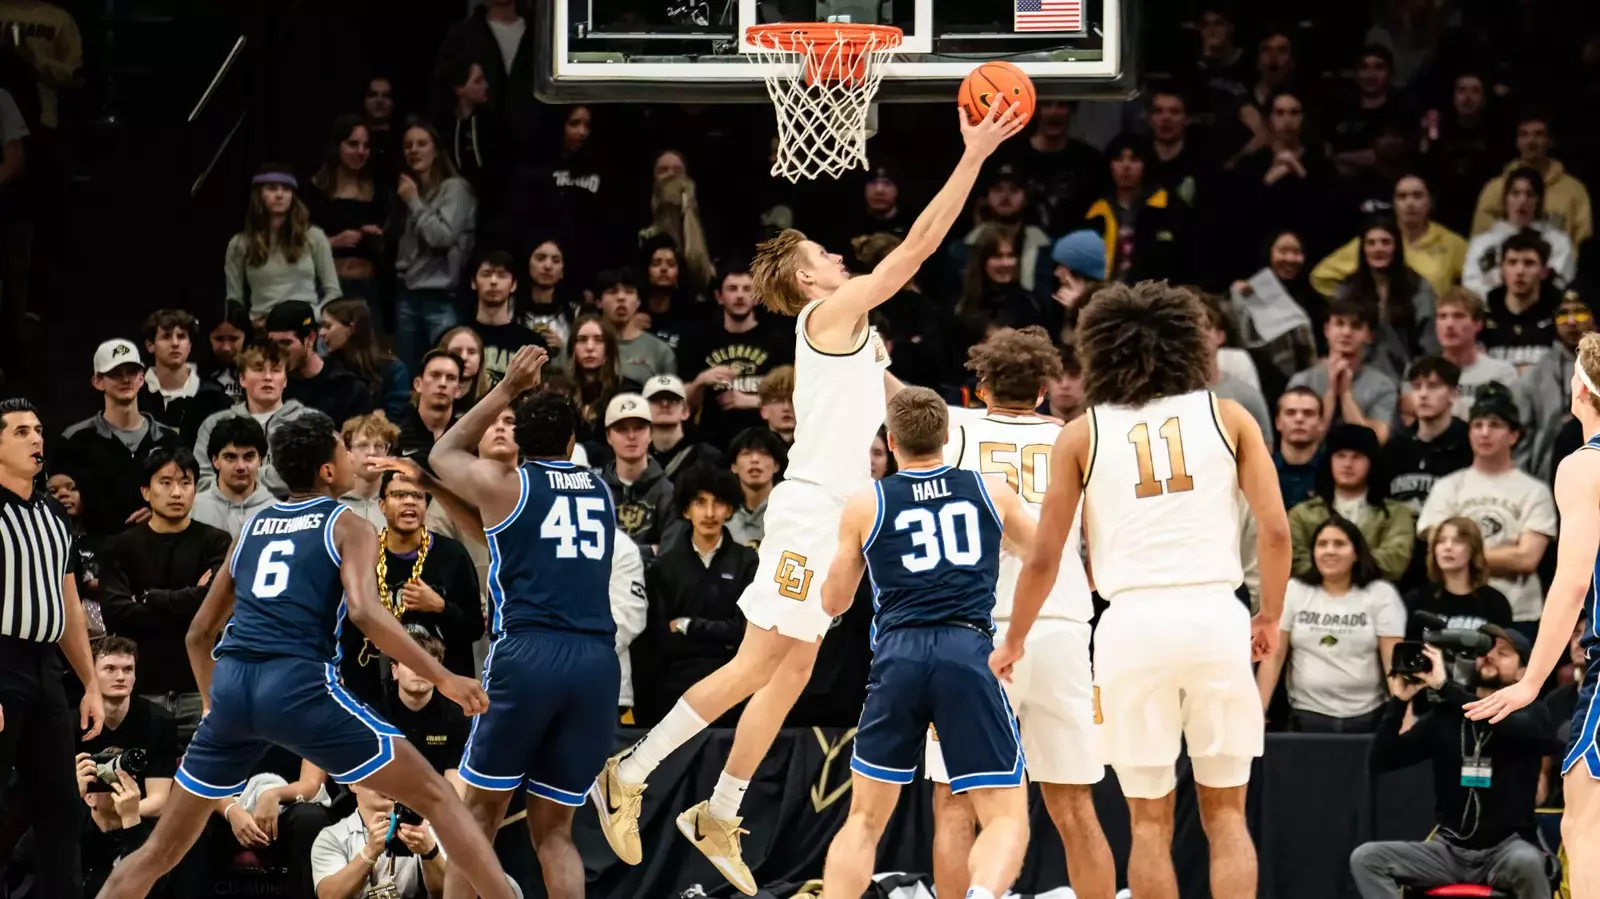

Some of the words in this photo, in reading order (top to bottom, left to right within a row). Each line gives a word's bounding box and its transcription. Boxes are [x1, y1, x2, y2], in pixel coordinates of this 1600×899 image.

[978, 440, 1053, 505] 50
[1126, 416, 1195, 500] 11
[911, 478, 953, 502] HALL
[251, 513, 325, 536] CATCHINGS
[540, 495, 606, 561] 45
[894, 500, 982, 574] 30
[251, 539, 296, 599] 6
[773, 549, 815, 603] CU
[1298, 610, 1368, 628] COLORADO
